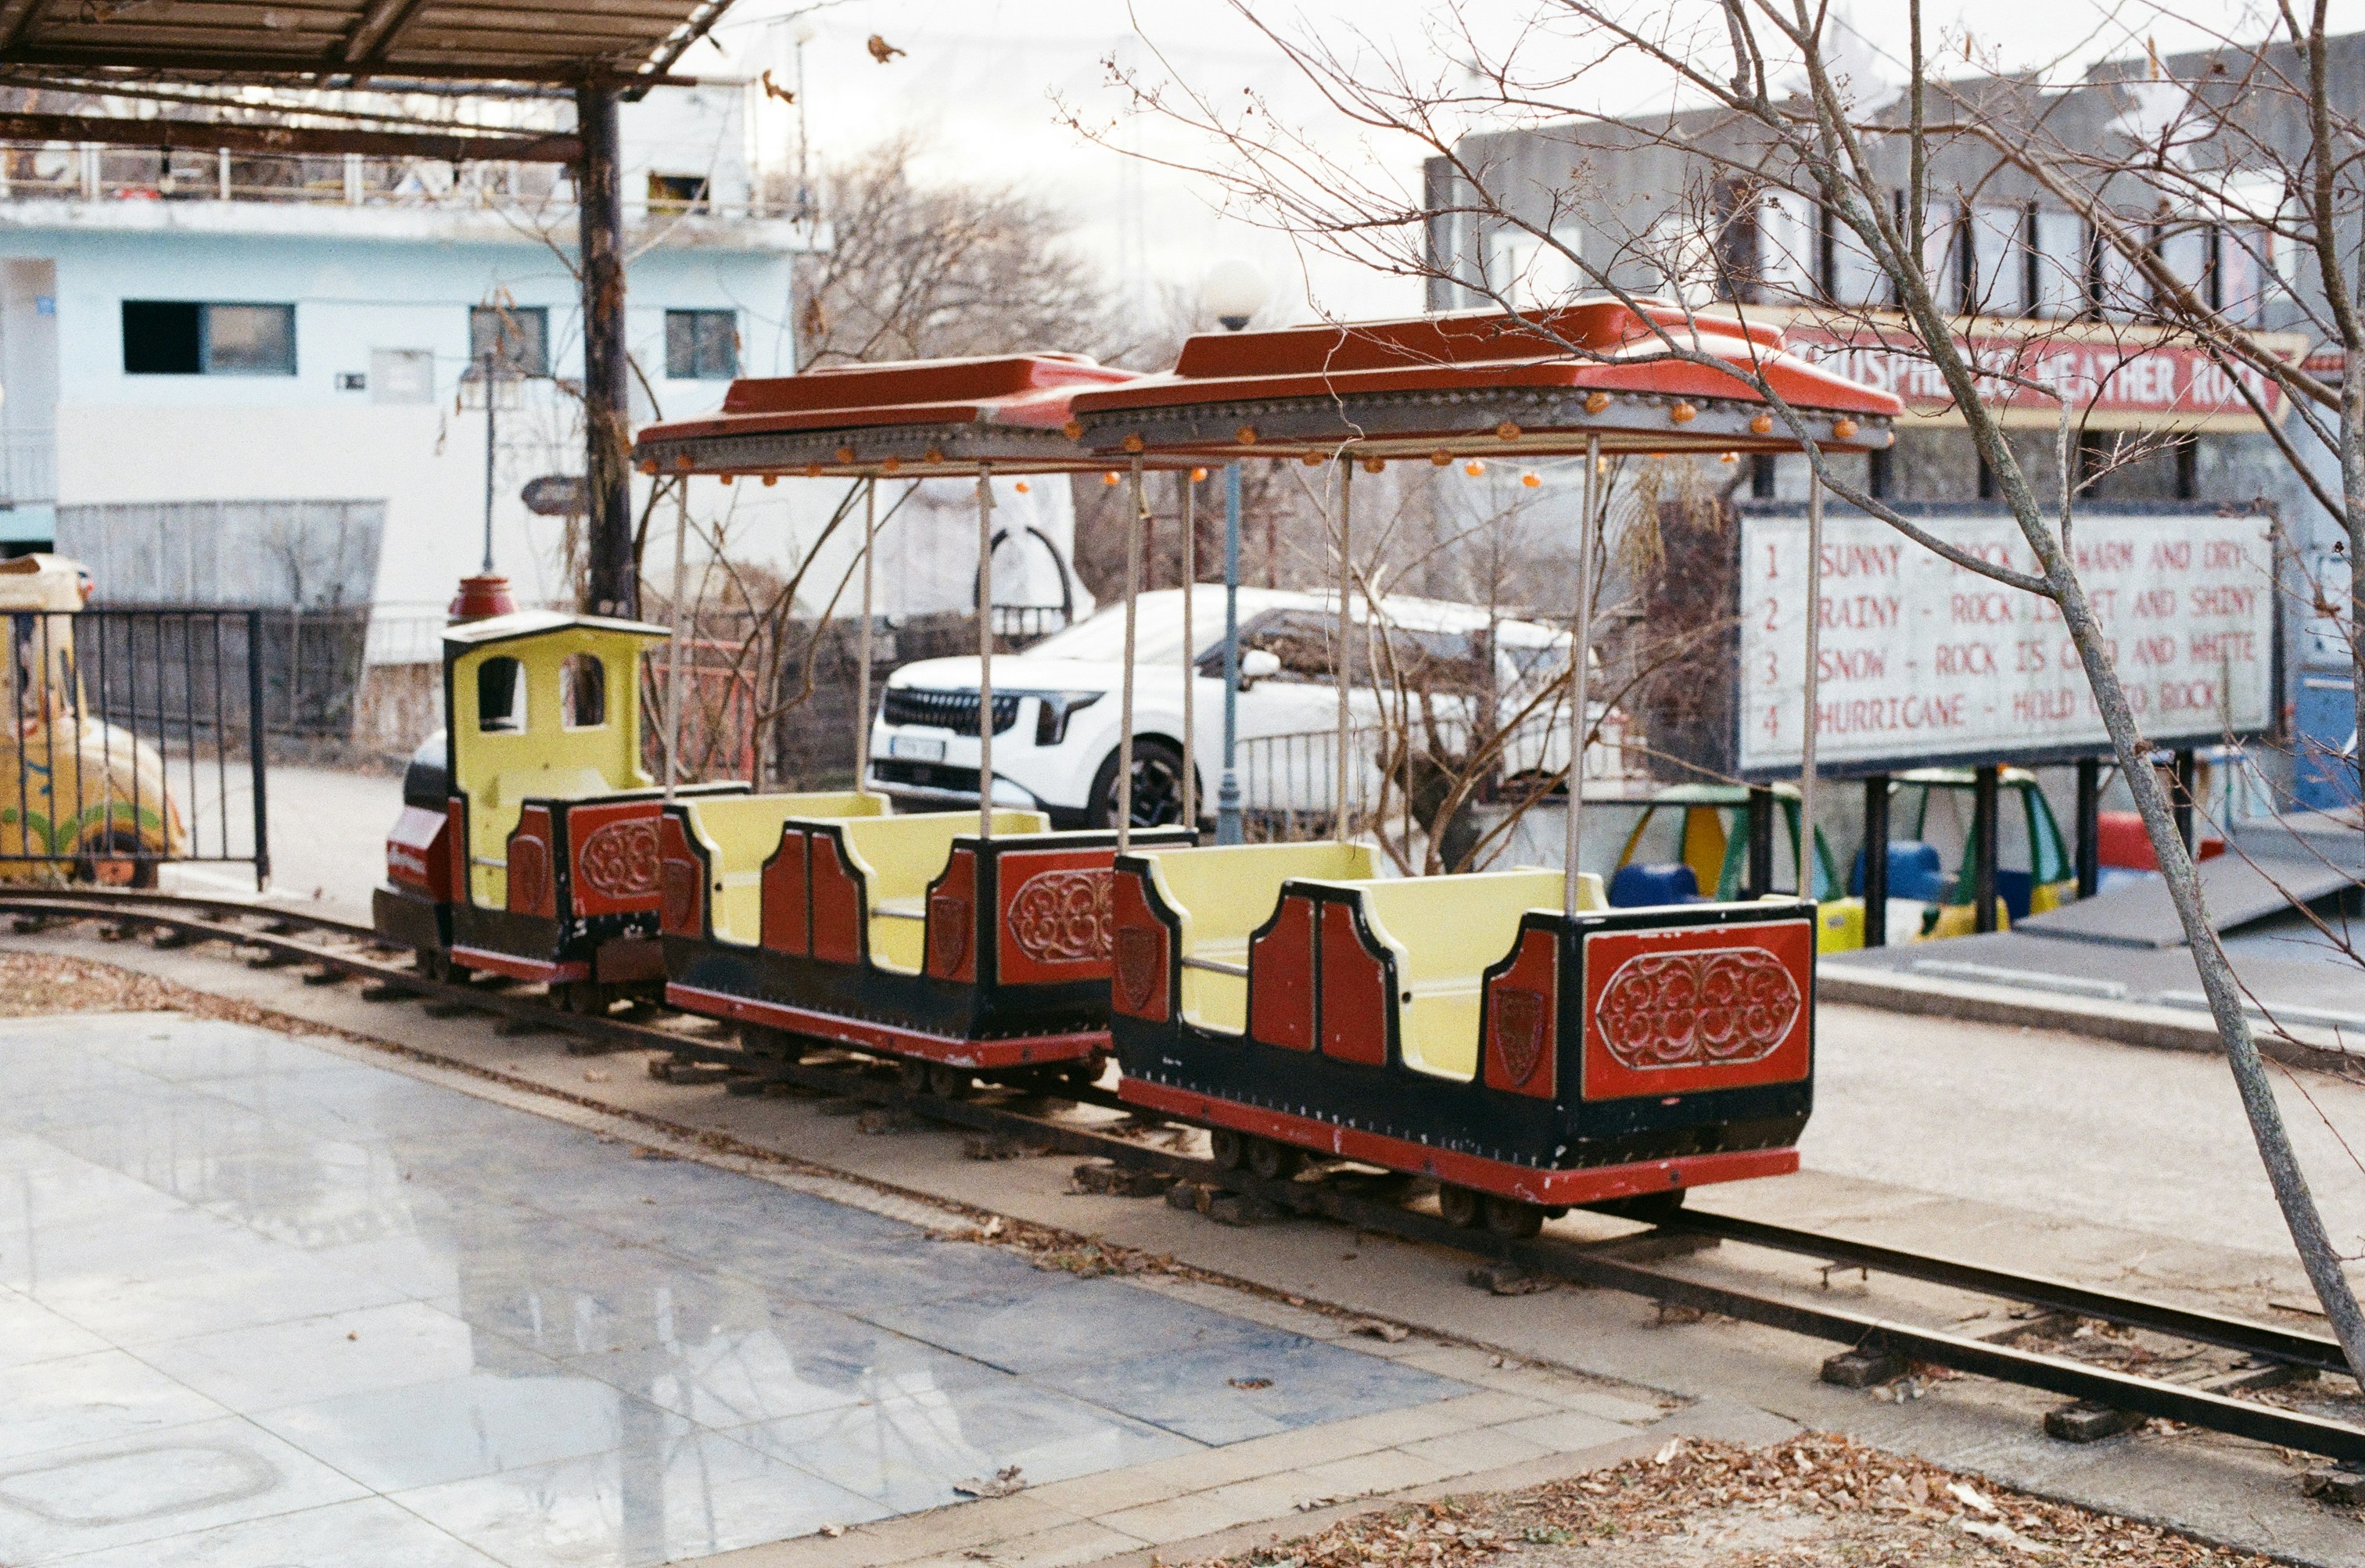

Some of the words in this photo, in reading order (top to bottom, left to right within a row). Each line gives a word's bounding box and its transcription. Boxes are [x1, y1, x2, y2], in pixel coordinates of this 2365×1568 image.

[2036, 351, 2177, 404] WEATHER
[1767, 544, 1778, 579] 1
[1819, 544, 1901, 578] SUNNY
[2076, 540, 2134, 571] WARM
[2151, 540, 2190, 571] AND
[2204, 540, 2247, 571] DRY
[1765, 597, 1778, 631] 2
[1818, 595, 1900, 629] RAINY
[1951, 592, 2013, 625] ROCK
[2089, 588, 2116, 619] ET
[2134, 588, 2177, 619] AND
[2190, 585, 2256, 617] SHINY
[1766, 650, 1778, 685] 3
[1818, 648, 1885, 683] SNOW
[1936, 641, 1997, 675] ROCK
[2016, 639, 2046, 673] IS
[2134, 635, 2177, 666] AND
[2190, 631, 2256, 662] WHITE
[1764, 704, 1778, 738] 4
[1815, 694, 1964, 734] HURRICANE
[2013, 688, 2075, 721] HOLD
[2160, 679, 2216, 711] ROCK
